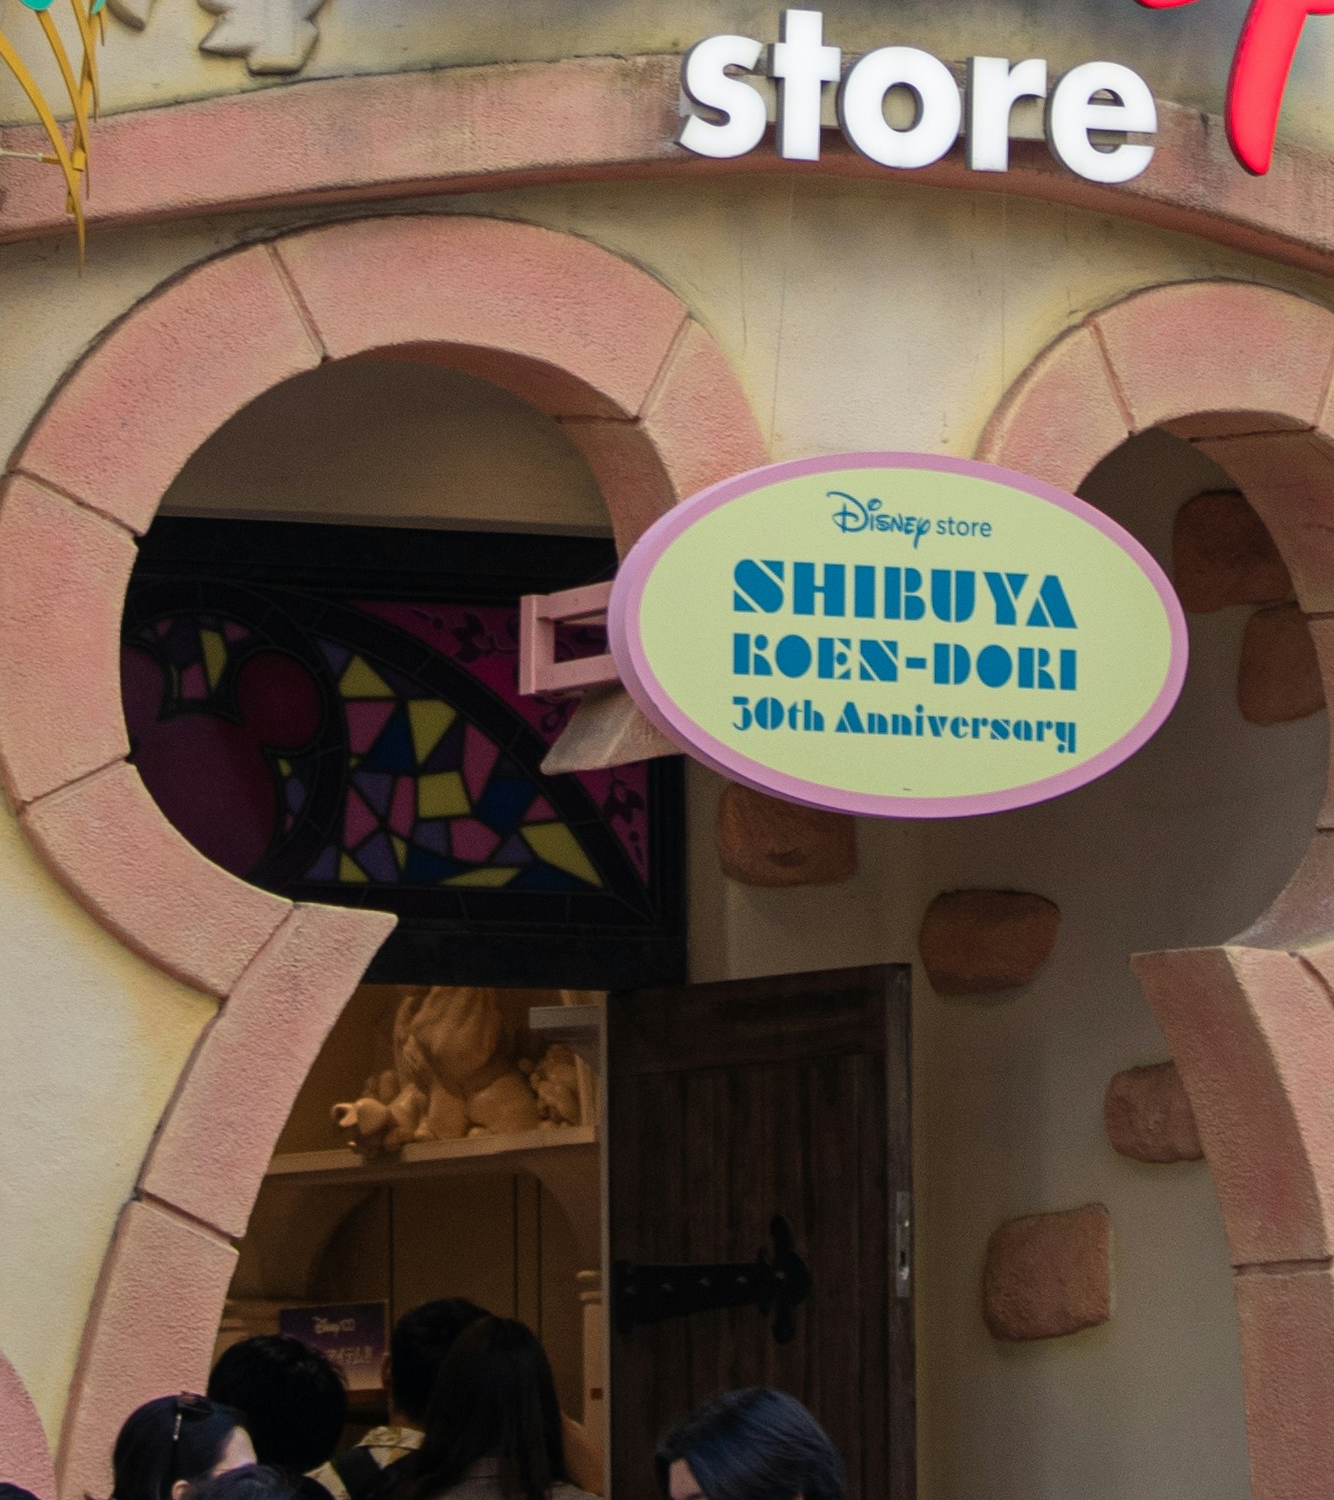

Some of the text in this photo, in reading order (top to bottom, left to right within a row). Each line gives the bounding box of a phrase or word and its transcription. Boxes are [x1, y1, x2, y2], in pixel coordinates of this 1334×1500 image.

[679, 8, 1157, 184] store
[825, 490, 993, 550] Disney store
[732, 558, 1079, 630] SHIBUYA
[732, 631, 1079, 692] KOEN-DORI
[732, 695, 1079, 755] 30th Anniversary
